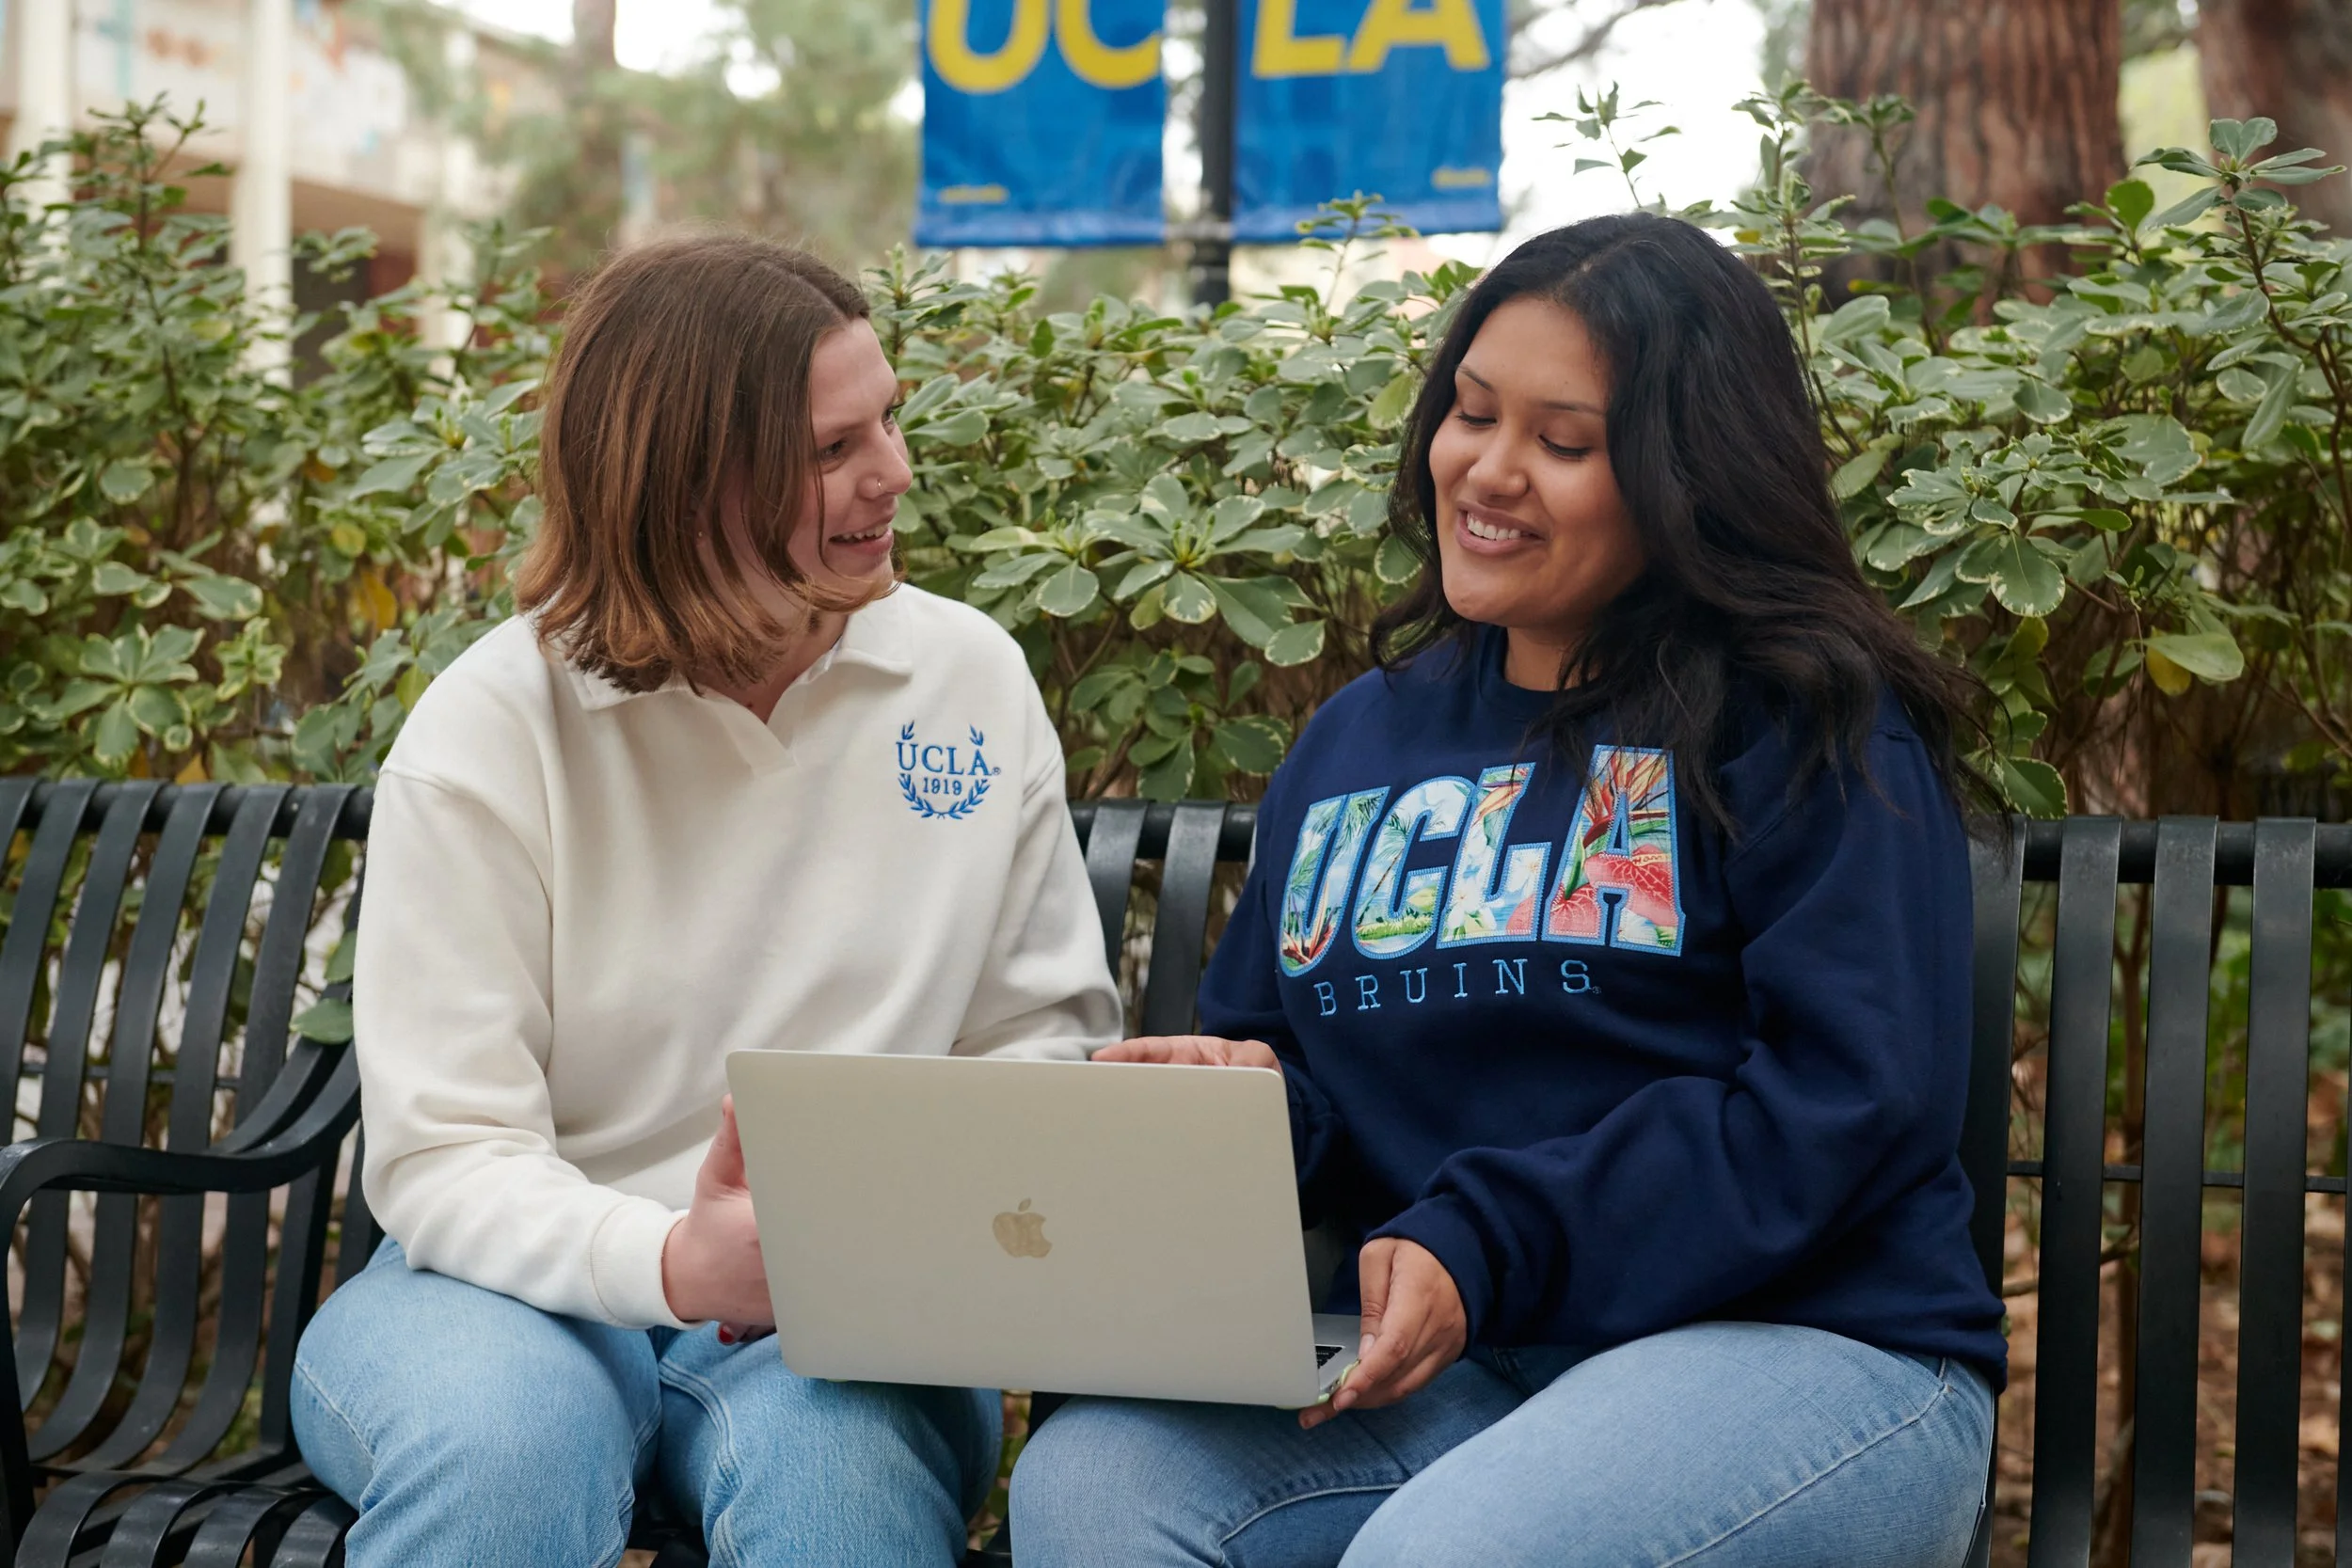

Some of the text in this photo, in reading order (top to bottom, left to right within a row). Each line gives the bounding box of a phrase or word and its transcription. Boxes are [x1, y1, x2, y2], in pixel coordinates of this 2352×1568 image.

[896, 741, 993, 777] UCLA
[922, 777, 962, 796] 1919
[1278, 743, 1686, 978] UCLA
[1313, 958, 1590, 1017] BRUINS
